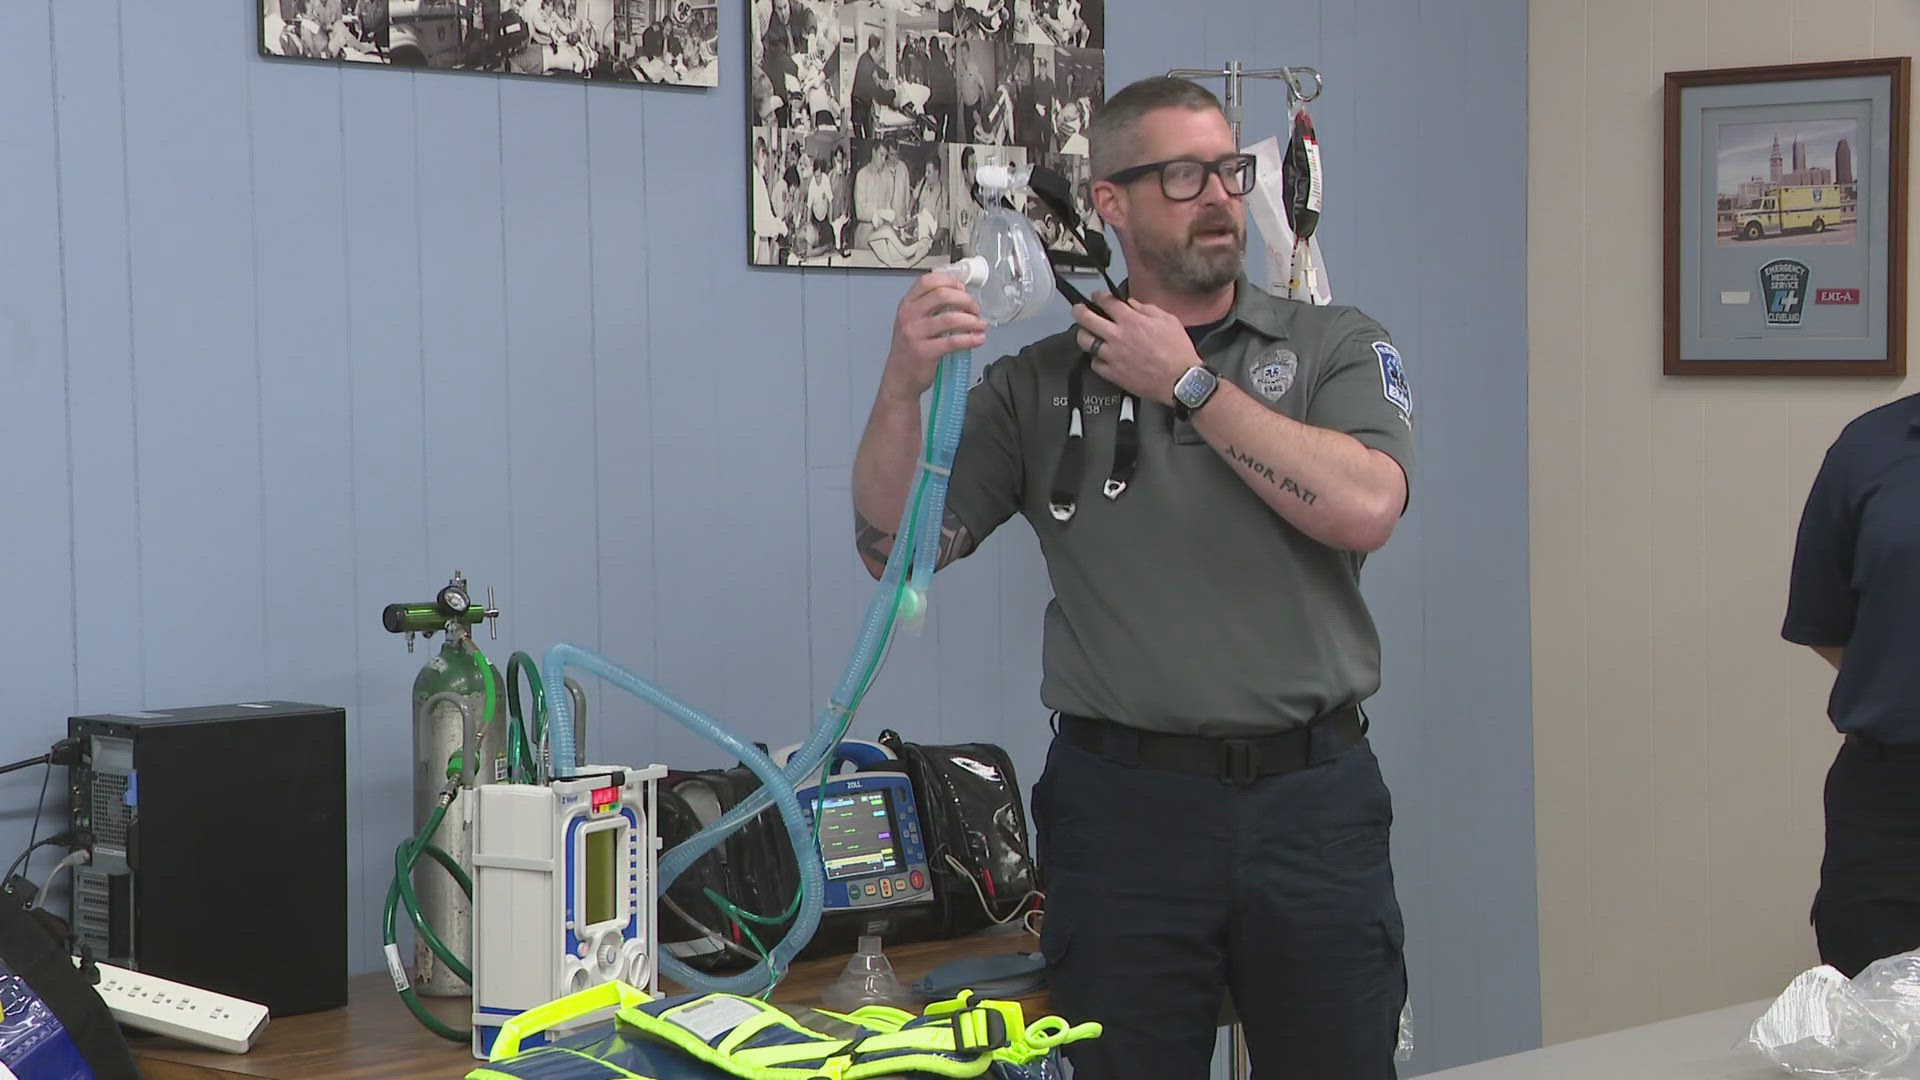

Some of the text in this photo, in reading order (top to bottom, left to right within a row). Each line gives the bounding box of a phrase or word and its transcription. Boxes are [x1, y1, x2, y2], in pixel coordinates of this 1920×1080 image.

[1764, 263, 1806, 276] EMERGENCY
[1770, 273, 1799, 282] MEDICAL
[1770, 281, 1799, 290] SERVICE
[1768, 312, 1800, 323] CLEVELAND
[1052, 396, 1068, 406] SG
[1225, 445, 1276, 484] AMOR
[846, 781, 863, 789] ZOLL
